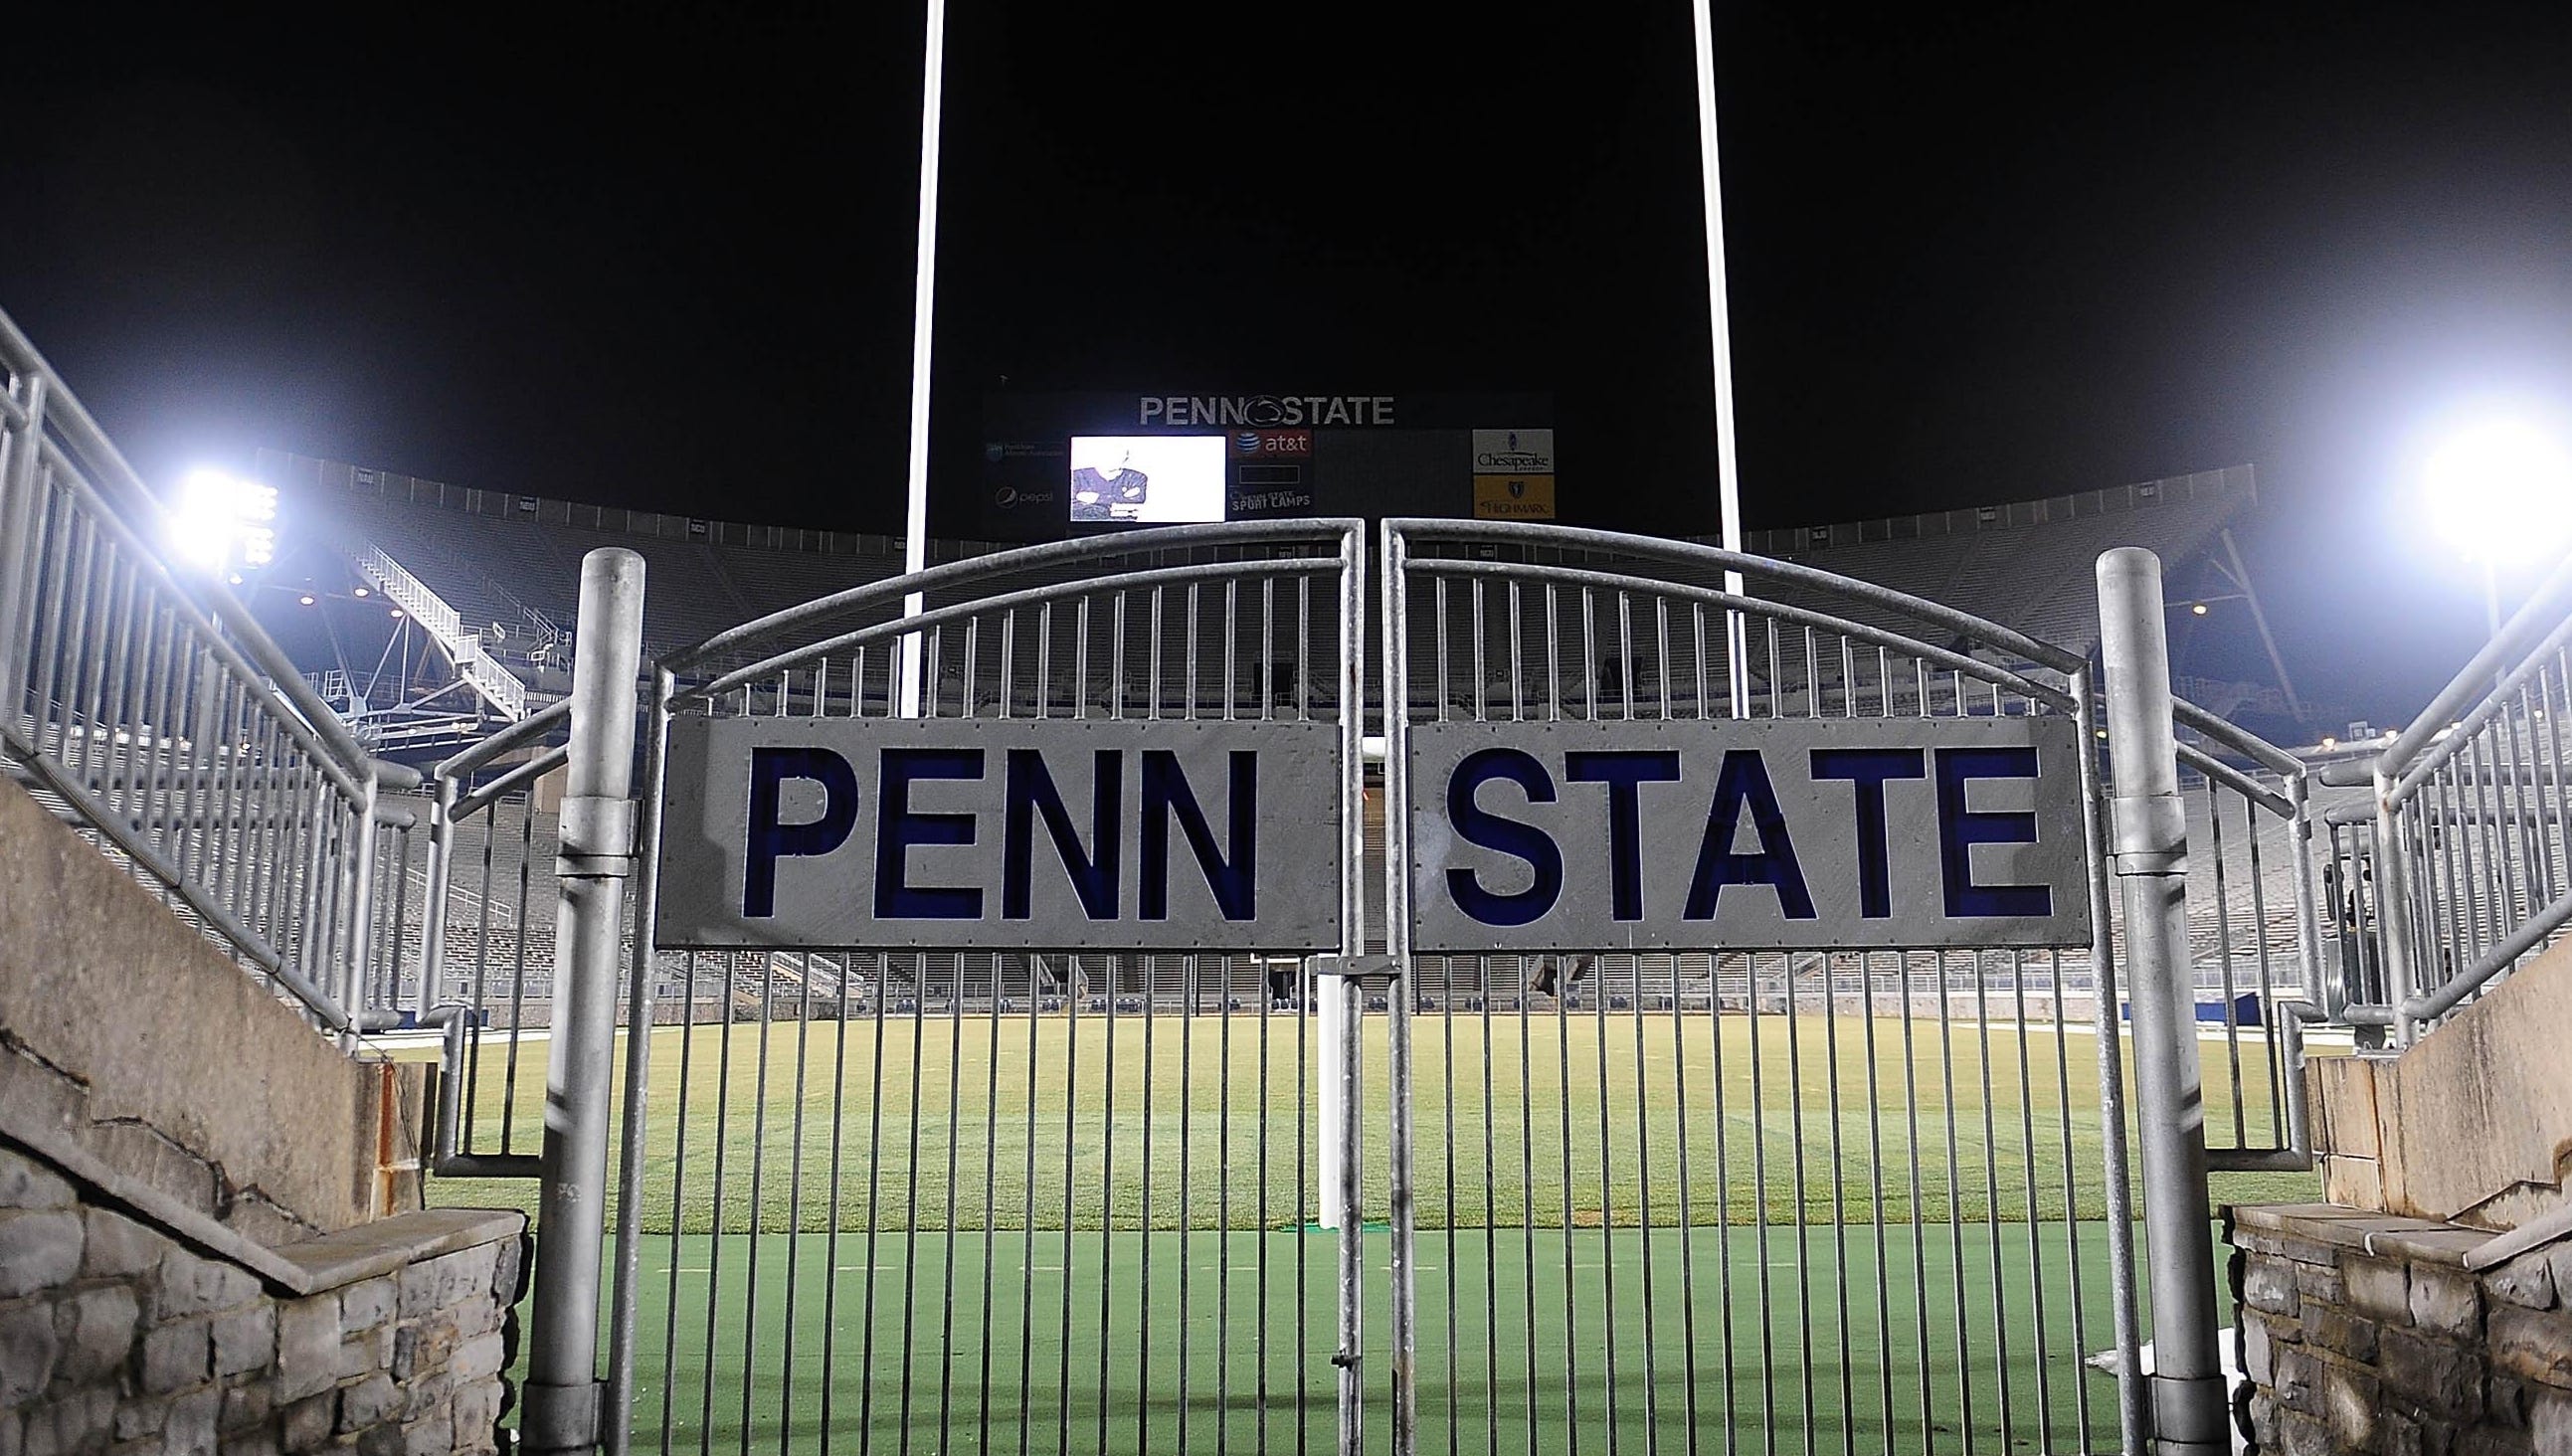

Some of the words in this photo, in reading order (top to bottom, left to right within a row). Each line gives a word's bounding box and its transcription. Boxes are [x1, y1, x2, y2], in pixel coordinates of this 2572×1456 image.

[1139, 397, 1243, 426] PENN
[1283, 396, 1394, 426] STATE
[1265, 435, 1307, 453] at&t
[1478, 453, 1549, 471] Chesapeake
[1019, 491, 1053, 503] pepsi
[1272, 496, 1310, 507] CAMPS
[742, 747, 1258, 921] PENN
[1445, 747, 2053, 926] STATE
